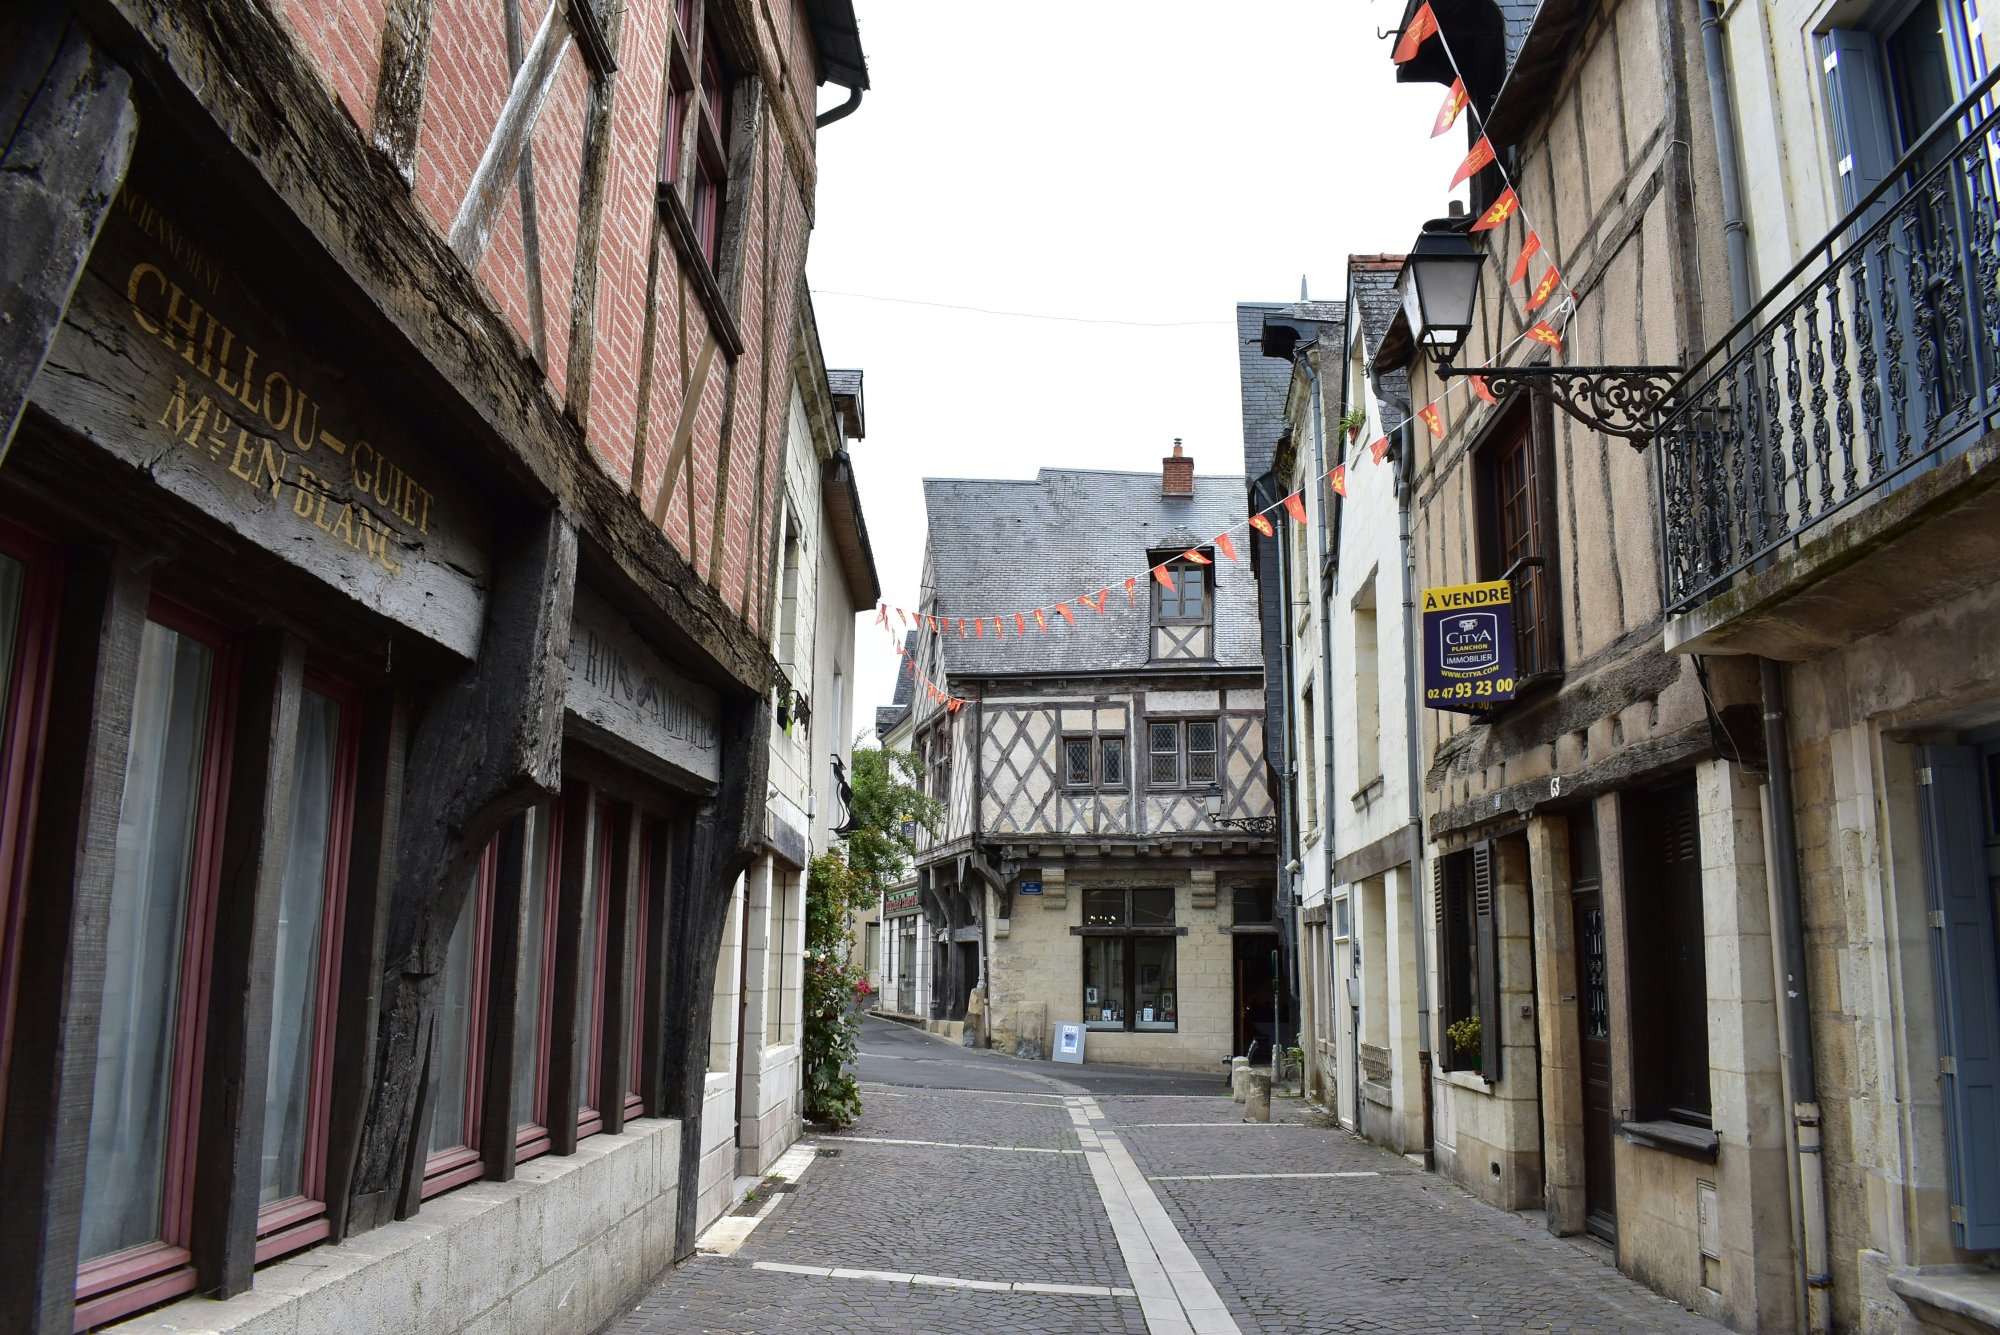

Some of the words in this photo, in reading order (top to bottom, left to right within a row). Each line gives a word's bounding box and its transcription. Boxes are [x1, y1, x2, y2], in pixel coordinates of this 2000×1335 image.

[116, 182, 223, 297] NCIENNEMENT
[228, 428, 290, 500] EN
[1425, 593, 1437, 609] À
[1441, 587, 1510, 607] VENDRE
[1451, 643, 1488, 652] PLANCHON
[584, 629, 616, 699] ROI
[1446, 653, 1493, 665] IMMOBILIER
[1441, 664, 1499, 679] WWW.CITYA.COM
[1427, 688, 1440, 699] 02
[1441, 687, 1454, 699] 47
[1455, 682, 1472, 699] 93
[1475, 680, 1492, 696] 23
[1496, 677, 1513, 693] 00
